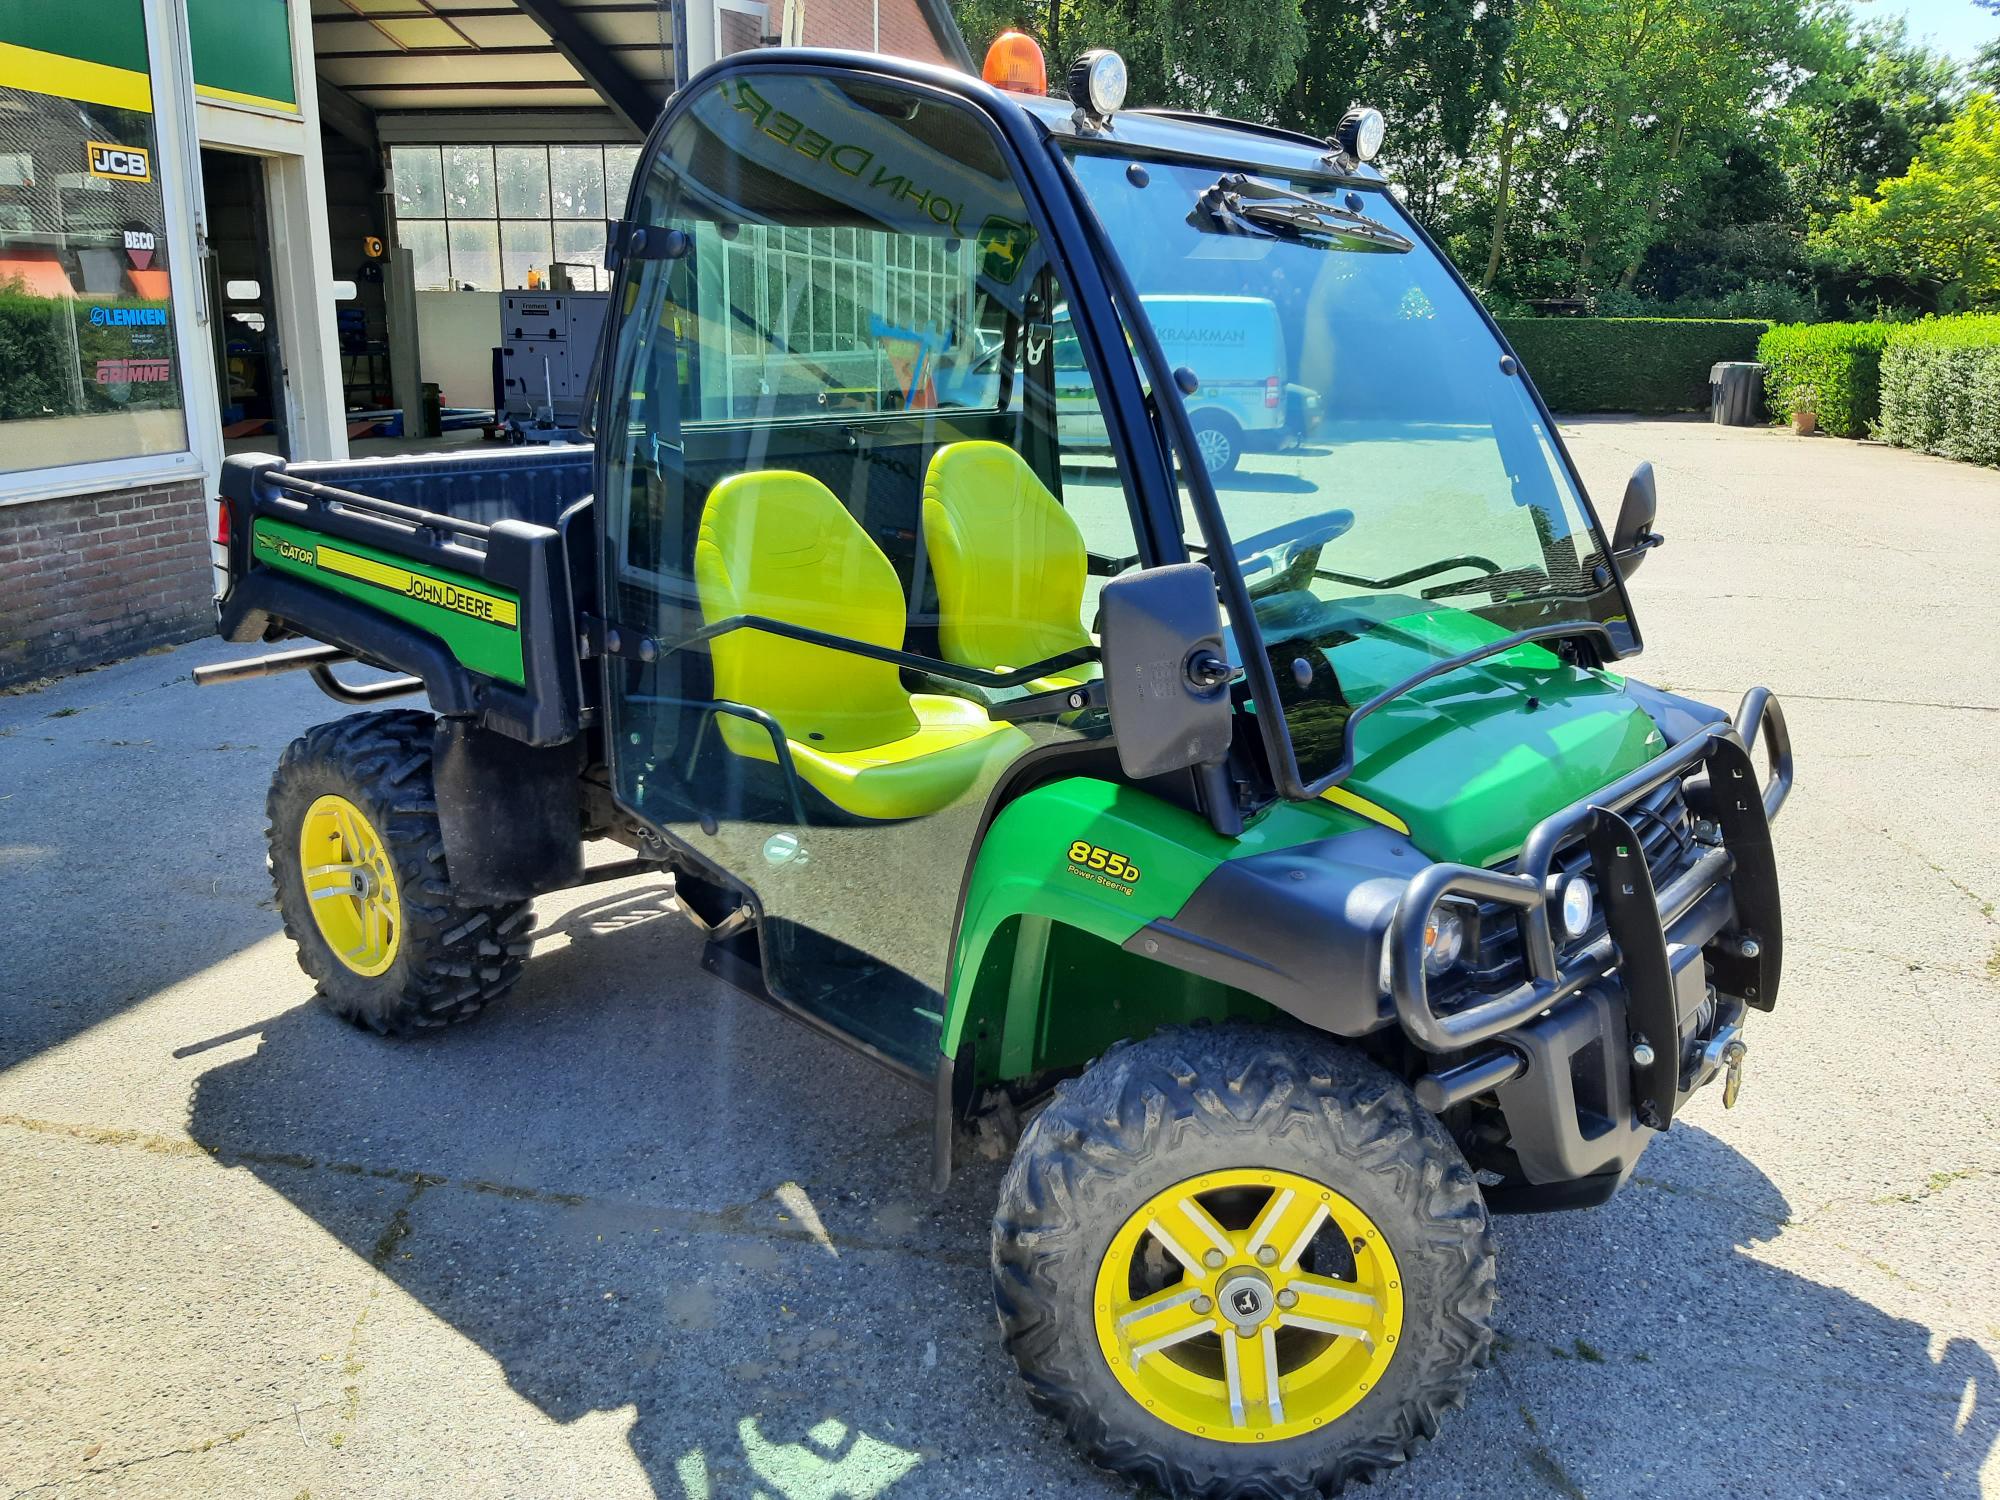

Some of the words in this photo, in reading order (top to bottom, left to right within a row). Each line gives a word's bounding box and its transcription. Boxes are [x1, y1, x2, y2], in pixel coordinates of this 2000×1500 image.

[94, 151, 146, 176] JCB
[123, 230, 155, 251] BECO
[104, 308, 166, 326] LEMKEN
[1157, 327, 1245, 342] KRAAKMAN
[96, 359, 170, 384] GRIMME
[279, 542, 314, 565] GATOR
[405, 576, 443, 604] JOHN
[445, 585, 494, 619] DEERE
[1068, 841, 1140, 883] 855D
[1068, 865, 1094, 880] Power
[1096, 876, 1133, 895] Steering
